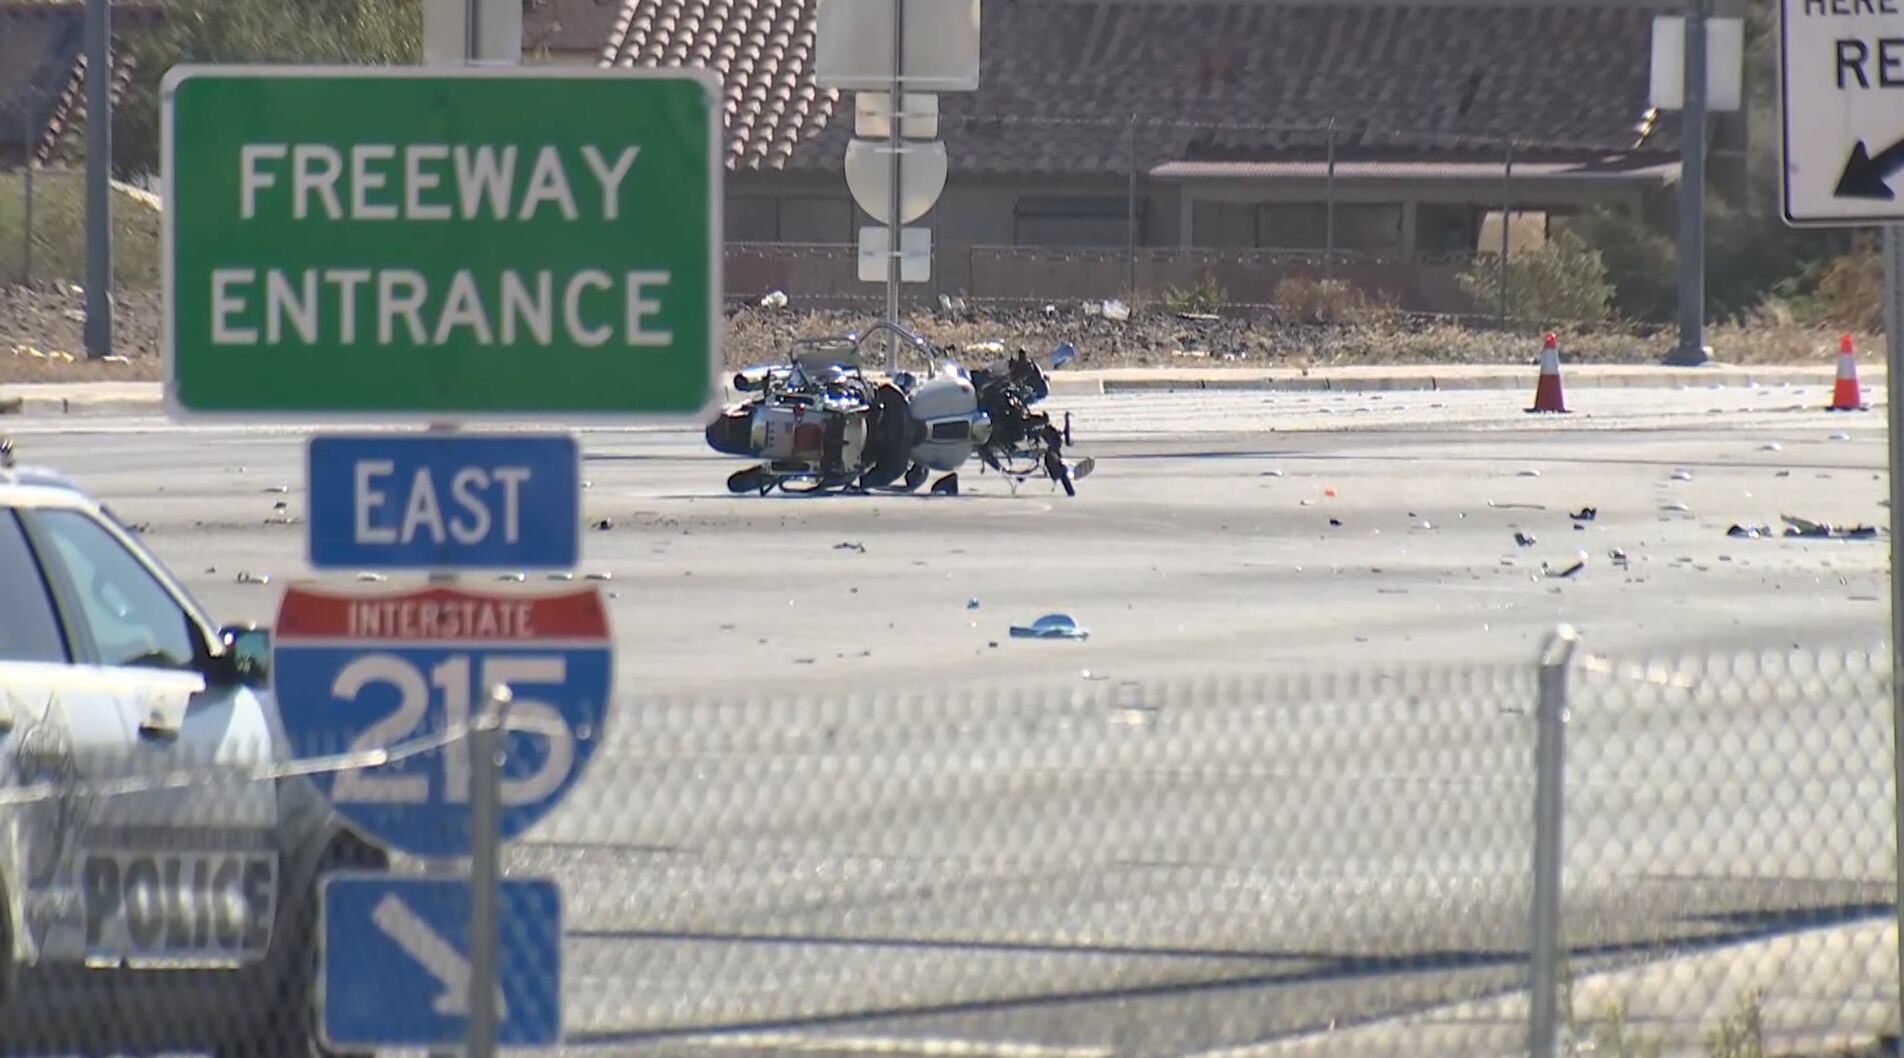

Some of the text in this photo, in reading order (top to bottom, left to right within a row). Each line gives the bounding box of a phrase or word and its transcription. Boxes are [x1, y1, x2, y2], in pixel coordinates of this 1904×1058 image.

[239, 144, 641, 221] FREEWAY
[211, 269, 674, 346] ENTRANCE
[354, 459, 532, 545] EAST
[348, 600, 535, 638] INTERSTATE
[330, 652, 575, 807] 215
[83, 856, 272, 949] POLICE
